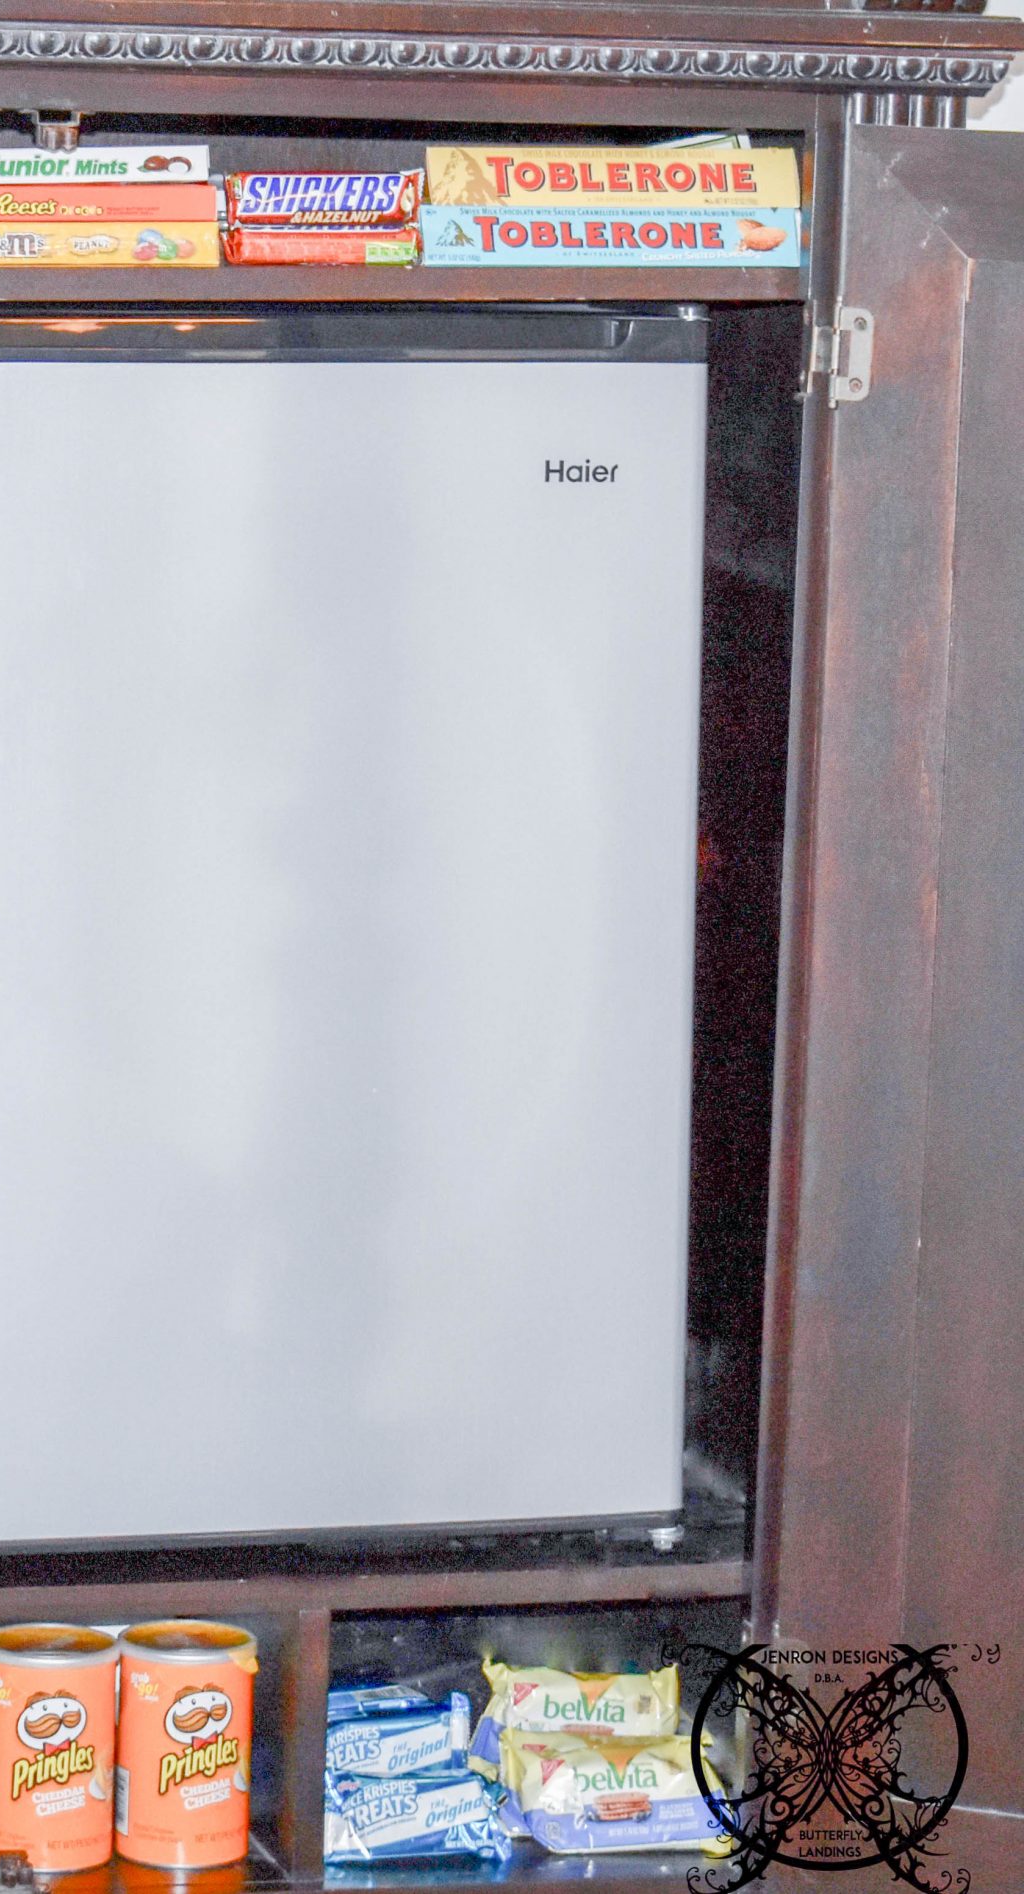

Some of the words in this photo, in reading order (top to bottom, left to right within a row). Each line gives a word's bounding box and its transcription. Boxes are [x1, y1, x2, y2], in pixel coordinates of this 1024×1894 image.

[74, 158, 129, 176] Mints
[485, 156, 757, 198] TOBLERONE
[240, 176, 401, 214] SNICKERS
[473, 215, 724, 253] TOBLERONE
[544, 459, 618, 482] Haier
[329, 1727, 381, 1748] KRISPIES
[387, 1735, 449, 1772] Original
[11, 1740, 95, 1801] Pringles
[158, 1734, 239, 1796] Pringles
[364, 1781, 418, 1800] KRISPIES
[343, 1794, 418, 1832] TREATS
[426, 1797, 484, 1829] Origina
